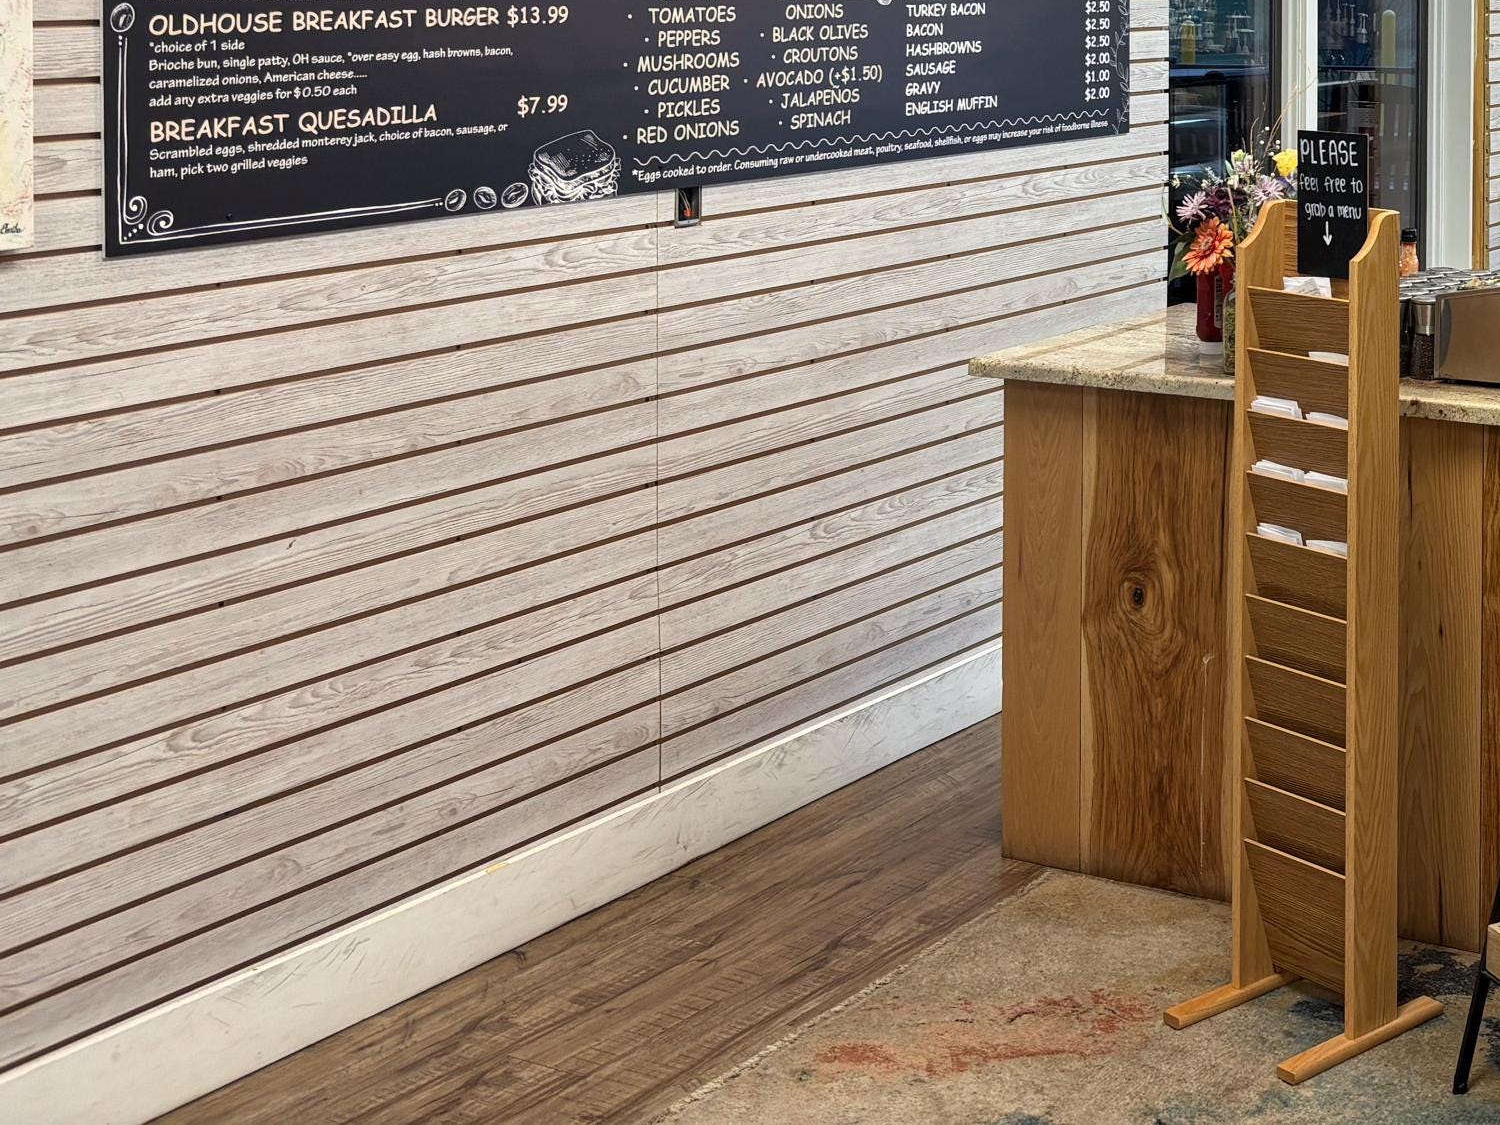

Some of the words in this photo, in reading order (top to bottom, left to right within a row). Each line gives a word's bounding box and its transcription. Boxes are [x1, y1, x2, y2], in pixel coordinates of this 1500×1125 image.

[148, 10, 283, 36] OLDHOUSE
[291, 8, 418, 31] BREAKFAST
[424, 5, 500, 27] BURGER
[506, 3, 569, 27] $13.99
[647, 4, 737, 24] TOMATOES
[784, 2, 844, 20] ONIONS
[771, 24, 815, 43] BLACK
[818, 22, 869, 41] OLIVES
[636, 50, 740, 73] MUSHROOMS
[755, 67, 824, 88] AVOCADO
[827, 63, 883, 88] (+$1.50)
[780, 84, 860, 109] JALAPEÑOS
[904, 97, 954, 117] ENGLISH
[955, 94, 998, 112] MUFFIN
[1083, 85, 1110, 102] $2.00
[149, 112, 290, 143] BREAKFAST
[297, 103, 437, 135] QUESADILLA
[516, 93, 568, 118] $7.99
[1300, 138, 1359, 167] PLEASE
[1299, 173, 1319, 193] feel
[1323, 176, 1347, 193] free
[1350, 177, 1363, 194] to
[1304, 202, 1326, 221] grab
[1328, 205, 1335, 218] a
[1337, 205, 1362, 220] menu
